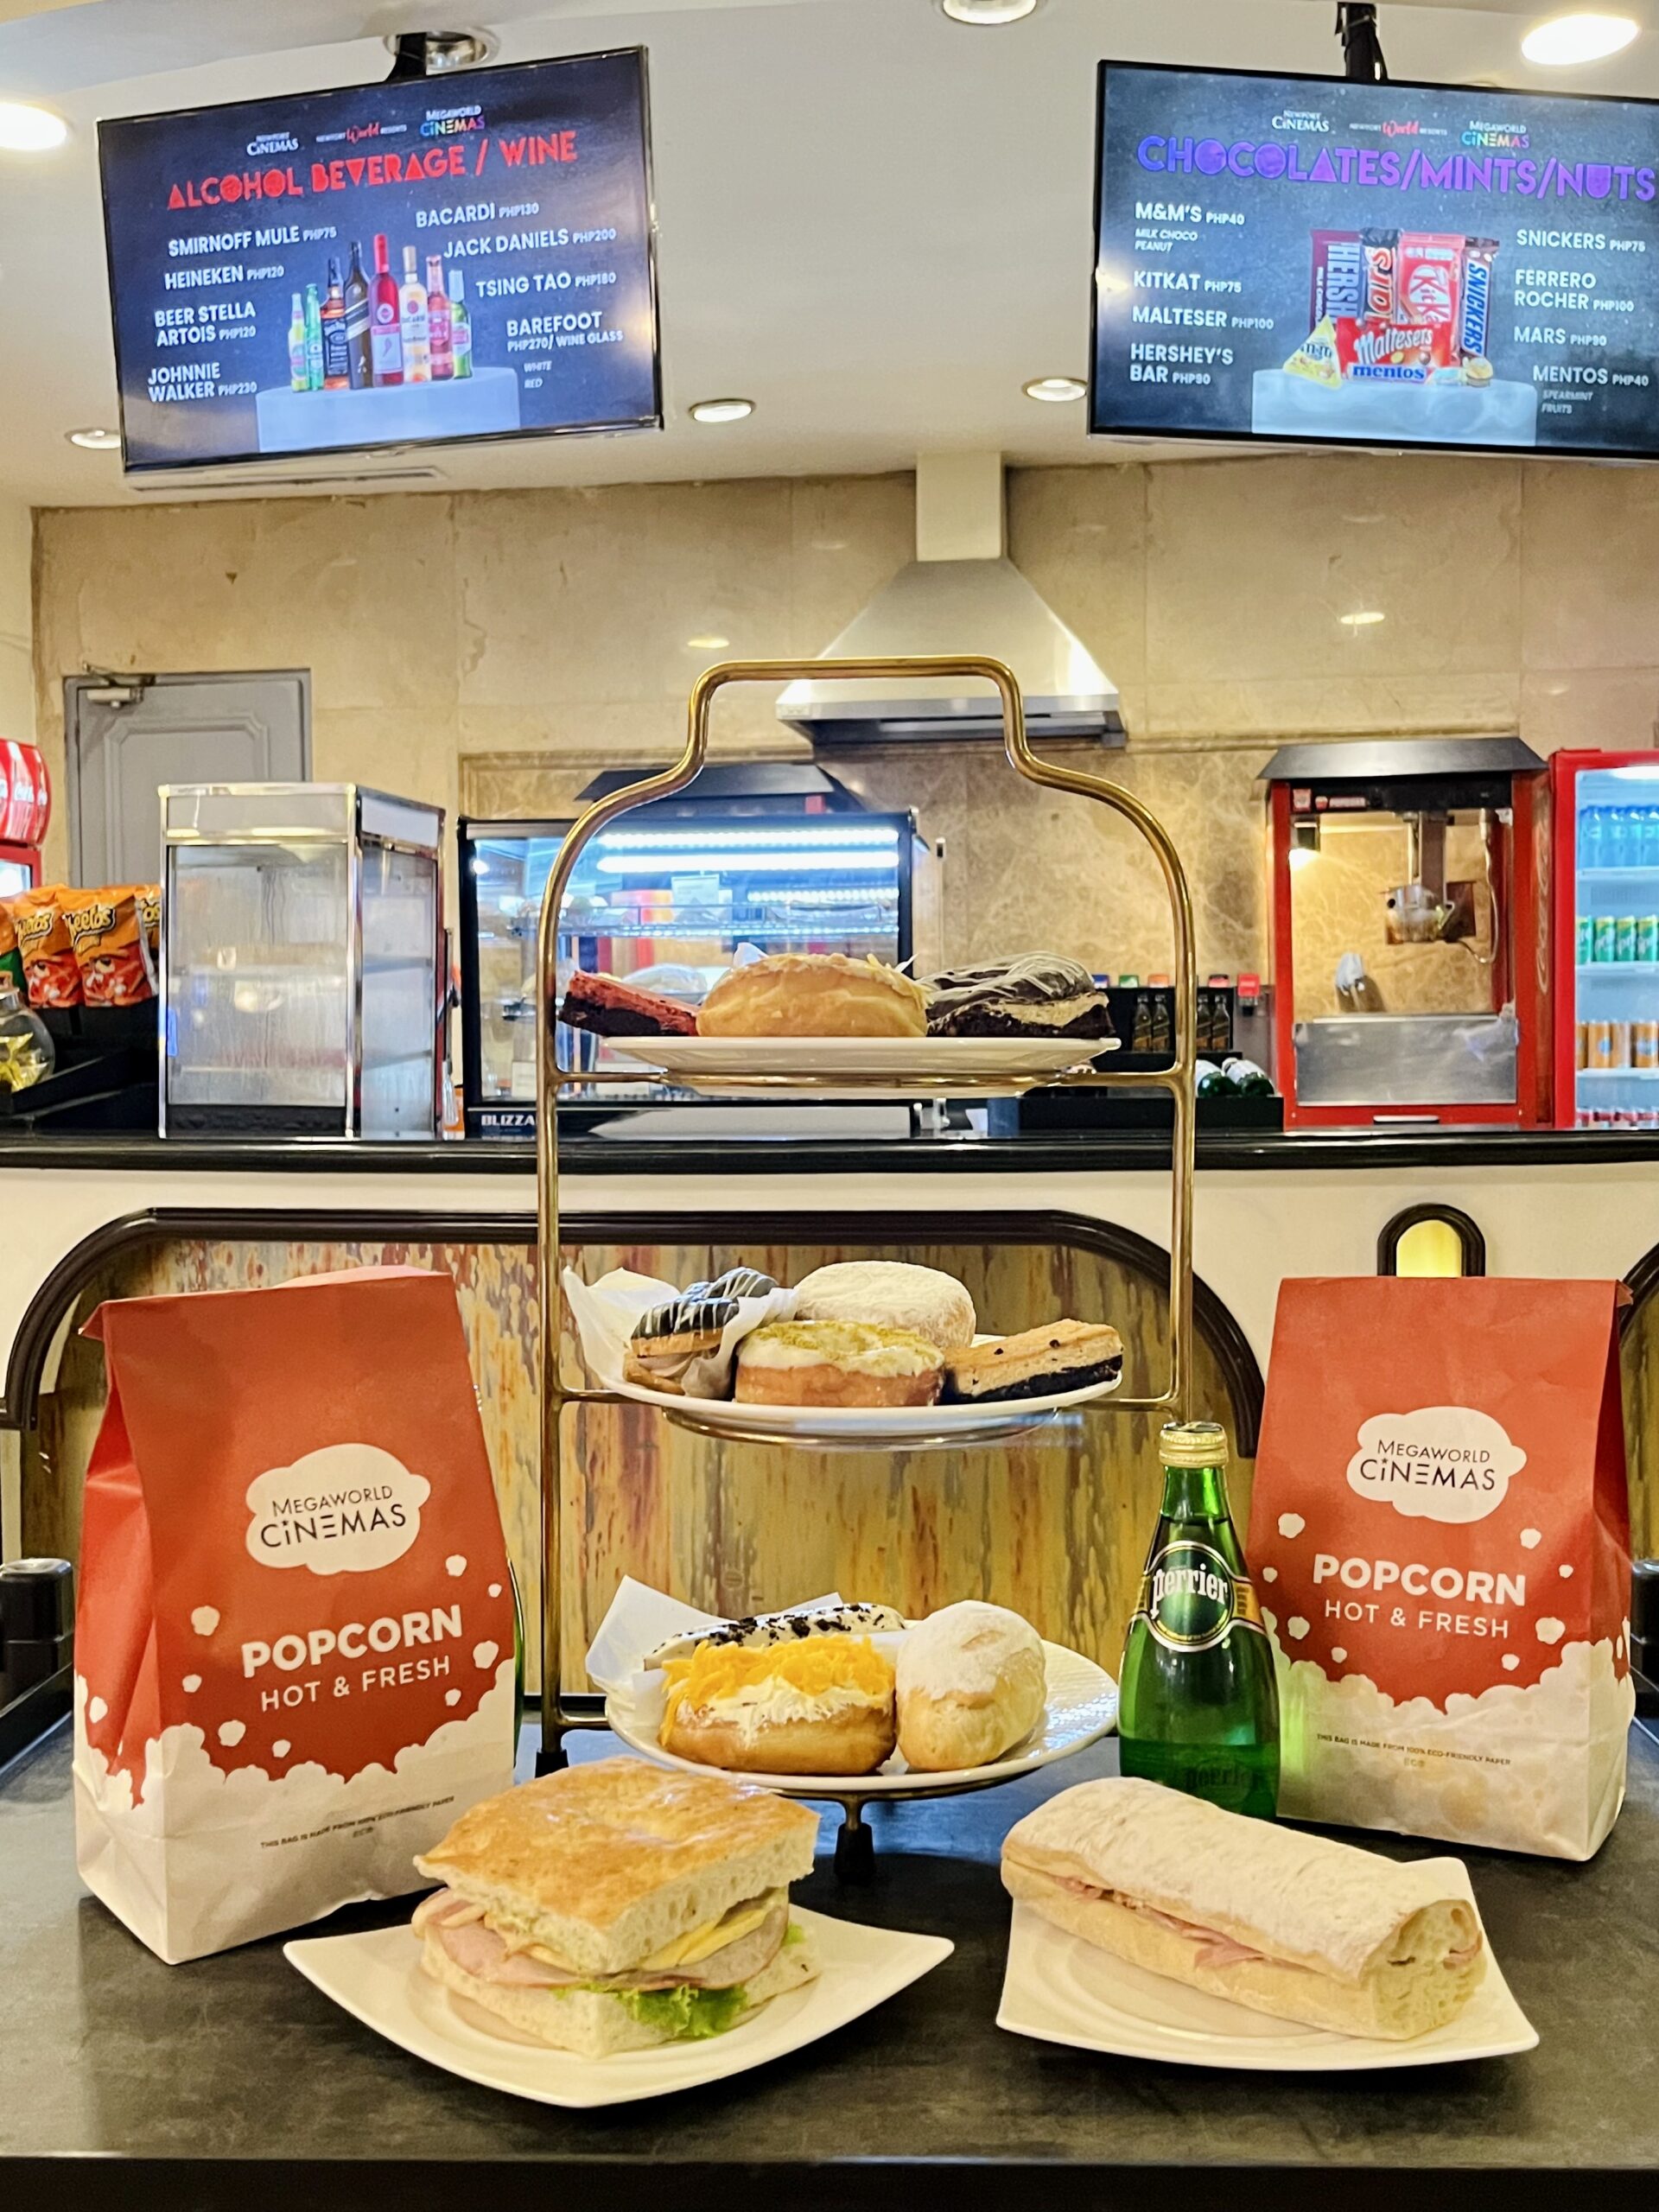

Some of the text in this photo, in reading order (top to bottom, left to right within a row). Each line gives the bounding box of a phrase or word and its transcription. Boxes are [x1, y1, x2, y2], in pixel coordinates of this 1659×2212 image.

[168, 130, 578, 210] ALCOHOL BEVERAGE / WINE
[1136, 134, 1656, 202] CHOCOLATES/MINTS/NUTS
[416, 202, 540, 228] BACARDI PHP130
[1135, 201, 1246, 226] M&M'S PHP40
[168, 230, 253, 257] SMIRNOFF
[255, 226, 301, 248] MULE
[443, 228, 617, 258] JACK DANIELS PHP200
[1135, 240, 1173, 253] PEANUT
[1159, 228, 1198, 241] CHOCO
[1516, 229, 1606, 251] SNICKERS
[164, 264, 245, 290] HEINEKEN
[475, 276, 530, 298] TSING
[532, 271, 572, 292] TAO
[1134, 270, 1243, 294] KITKAT PHP75
[1325, 245, 1361, 320] HERSH
[1366, 247, 1394, 319] ars
[1515, 269, 1597, 289] FERRERO
[154, 301, 257, 327] BEER STELLA
[1463, 262, 1489, 356] SNICKERS
[1514, 289, 1635, 313] ROCHER PHP100
[506, 310, 603, 338] BAREFOOT
[1132, 305, 1274, 330] MALTESER PHP100
[156, 325, 216, 347] ARTOIS
[556, 333, 586, 347] WINE
[588, 330, 624, 345] GLASS
[1353, 327, 1433, 365] Maltesers
[1514, 325, 1567, 345] MARS
[1130, 342, 1234, 365] HERSHEY'S
[148, 362, 221, 385] JOHNNIE
[1129, 364, 1169, 384] BAR
[1352, 365, 1426, 380] mentos
[1533, 364, 1649, 387] MENTOS PHP40
[147, 381, 216, 404] WALKER
[480, 1114, 536, 1126] BLIZZA
[1376, 1439, 1491, 1464] MEGAWORLD
[271, 1484, 393, 1517] MEGAWORLD
[1313, 1553, 1526, 1607] POPCORN
[1325, 1599, 1509, 1639] HOT & FRESH
[241, 1604, 463, 1679] POPCORN
[261, 1655, 450, 1713] HOT & FRESH
[1317, 1732, 1332, 1742] THIS
[1334, 1735, 1350, 1745] BAG
[1360, 1740, 1381, 1749] MADE
[1382, 1743, 1404, 1752] FROM
[1407, 1746, 1426, 1756] 100%
[1427, 1749, 1484, 1762] ECO-FRIENDLY
[1484, 1756, 1511, 1766] PAPER
[261, 1840, 279, 1849] THIS
[281, 1834, 299, 1846] BAG
[300, 1833, 308, 1841] IS
[309, 1826, 331, 1839] MADE
[332, 1820, 356, 1832] FROM
